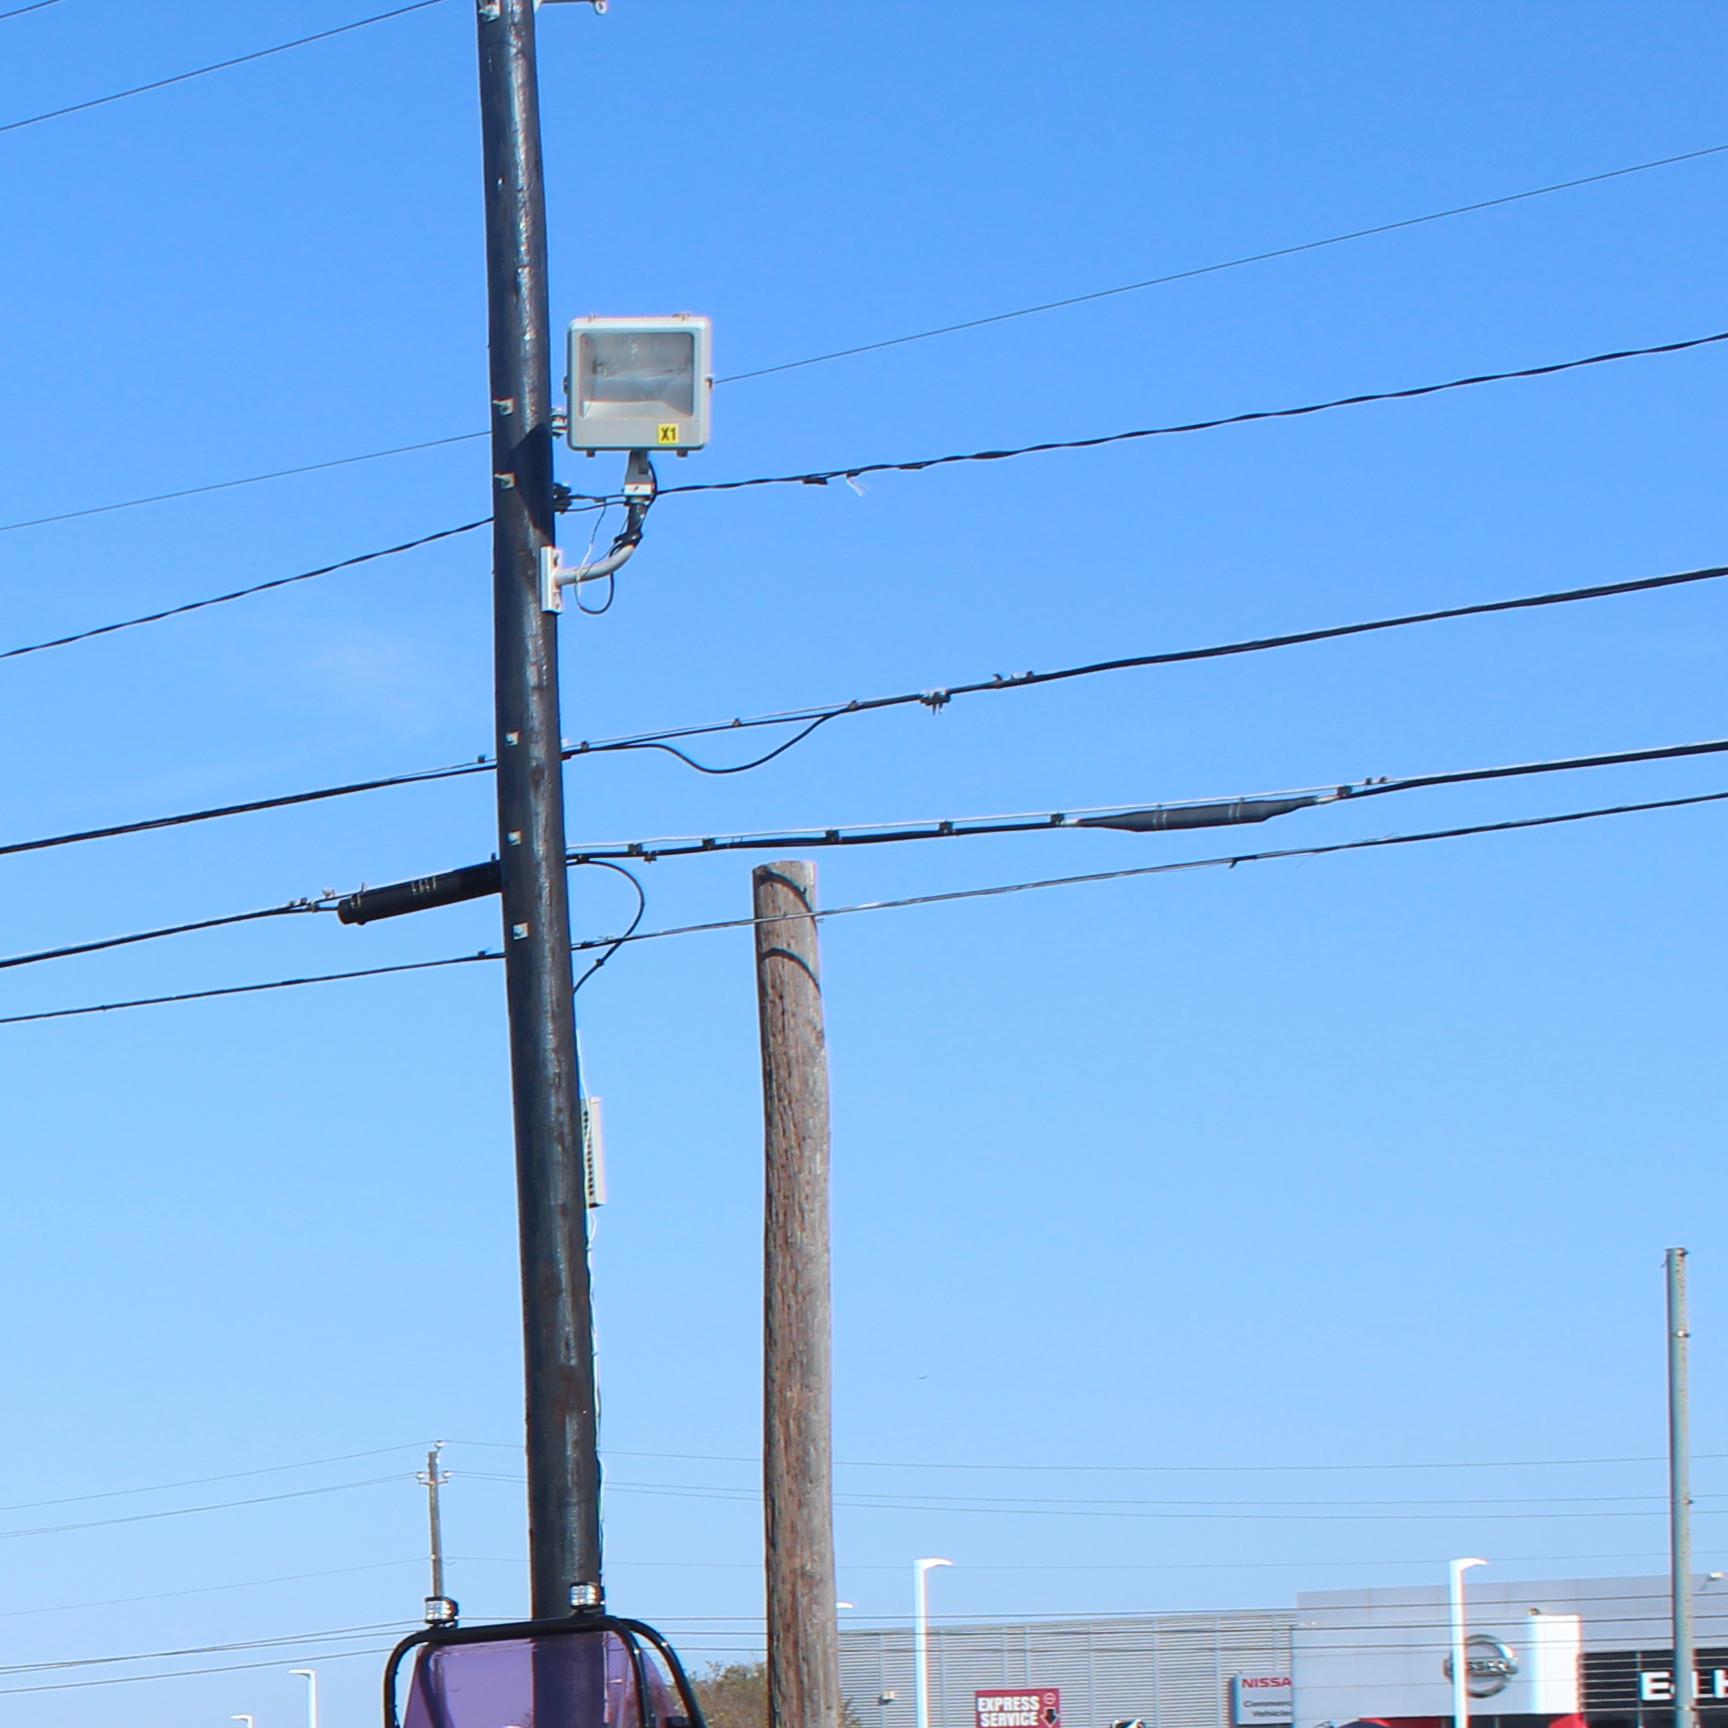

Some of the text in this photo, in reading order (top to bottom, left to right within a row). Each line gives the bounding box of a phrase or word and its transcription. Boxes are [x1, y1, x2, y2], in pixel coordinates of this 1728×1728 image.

[661, 427, 676, 441] X1
[1241, 1677, 1292, 1688] NISSA
[977, 1695, 1040, 1712] EXPRESS
[980, 1711, 1039, 1728] SERVICE
